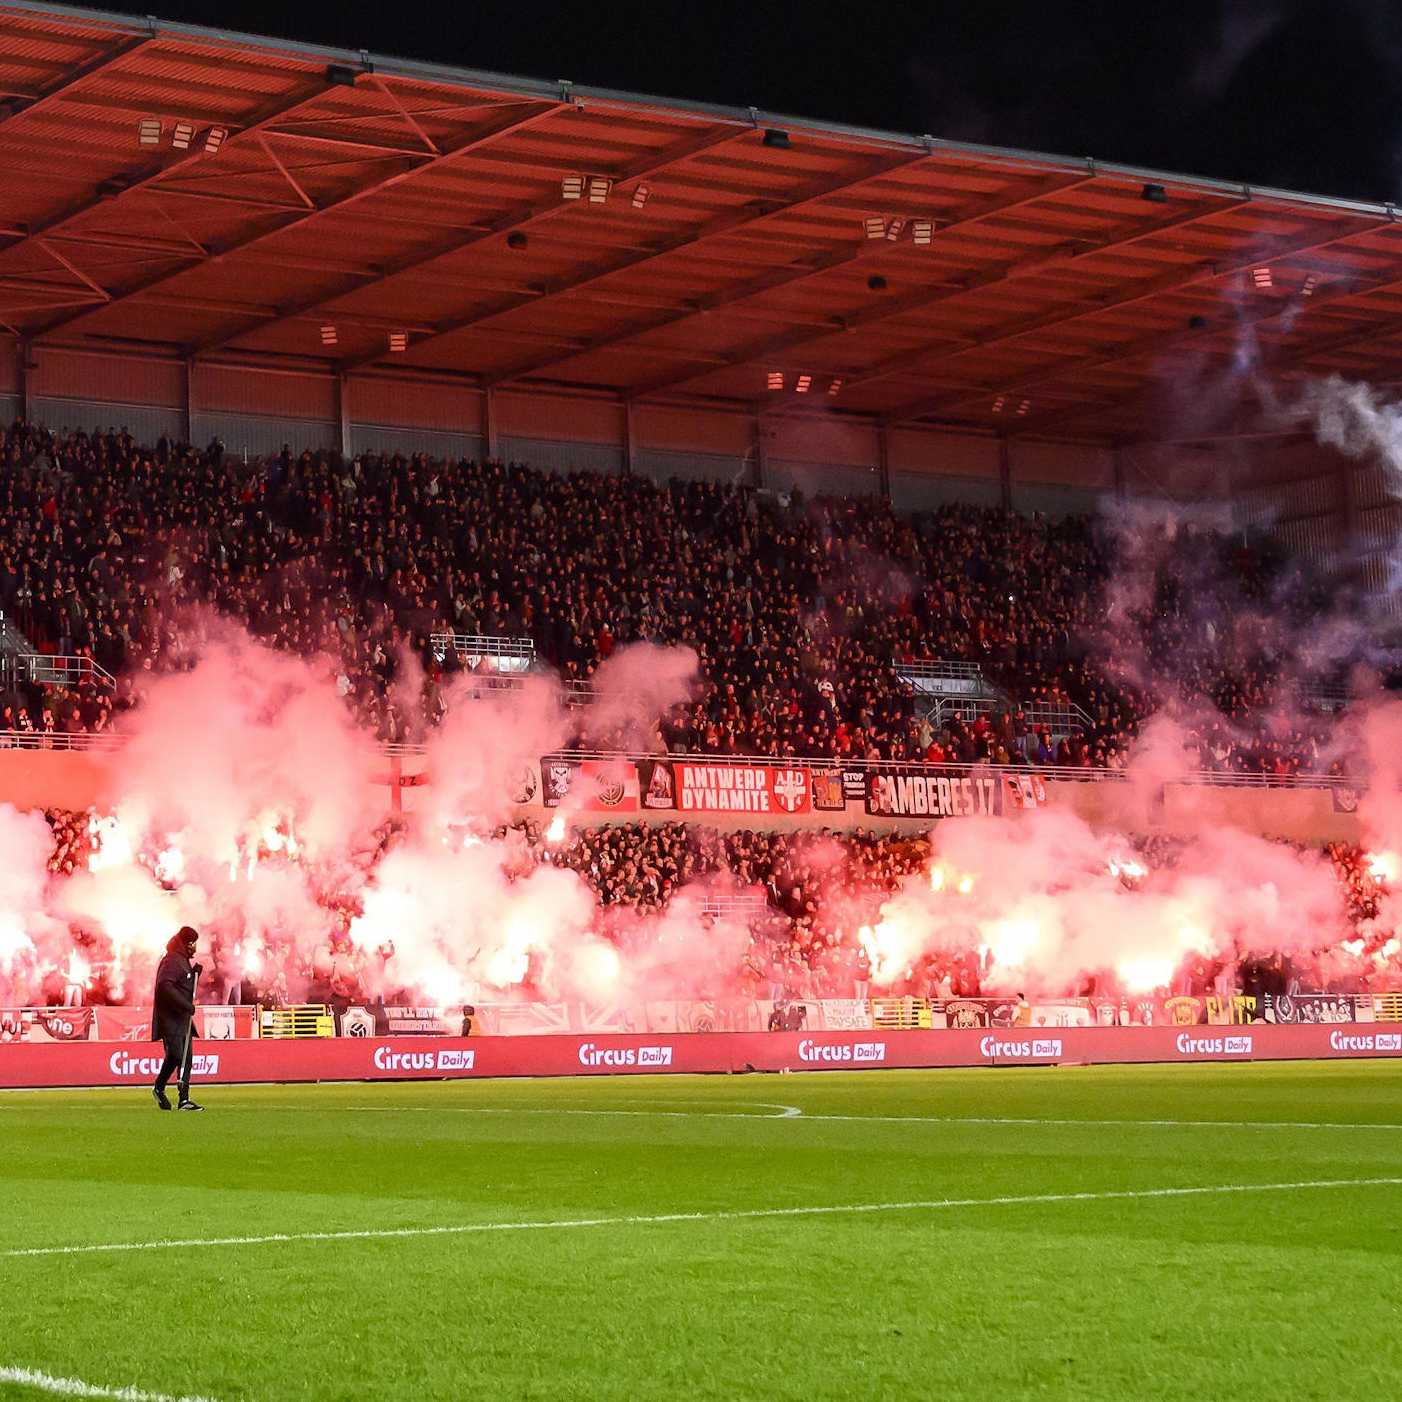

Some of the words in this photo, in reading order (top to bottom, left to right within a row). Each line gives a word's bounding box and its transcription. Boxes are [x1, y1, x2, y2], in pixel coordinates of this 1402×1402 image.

[683, 767, 766, 790] ANTWERP
[843, 772, 864, 781] STOP
[681, 788, 769, 811] DYNAMITE
[797, 1039, 851, 1061] Circus
[857, 1045, 882, 1061] Daily
[980, 1036, 1030, 1058] Circus
[1035, 1042, 1059, 1056] Daily
[1176, 1033, 1223, 1054] Circus
[1227, 1039, 1250, 1053] Daily
[1330, 1030, 1374, 1051] Circus
[109, 1051, 164, 1075] Circu
[374, 1046, 435, 1070] Circus
[441, 1053, 470, 1069] Daily
[578, 1043, 636, 1066] Circus
[642, 1049, 669, 1065] Daily
